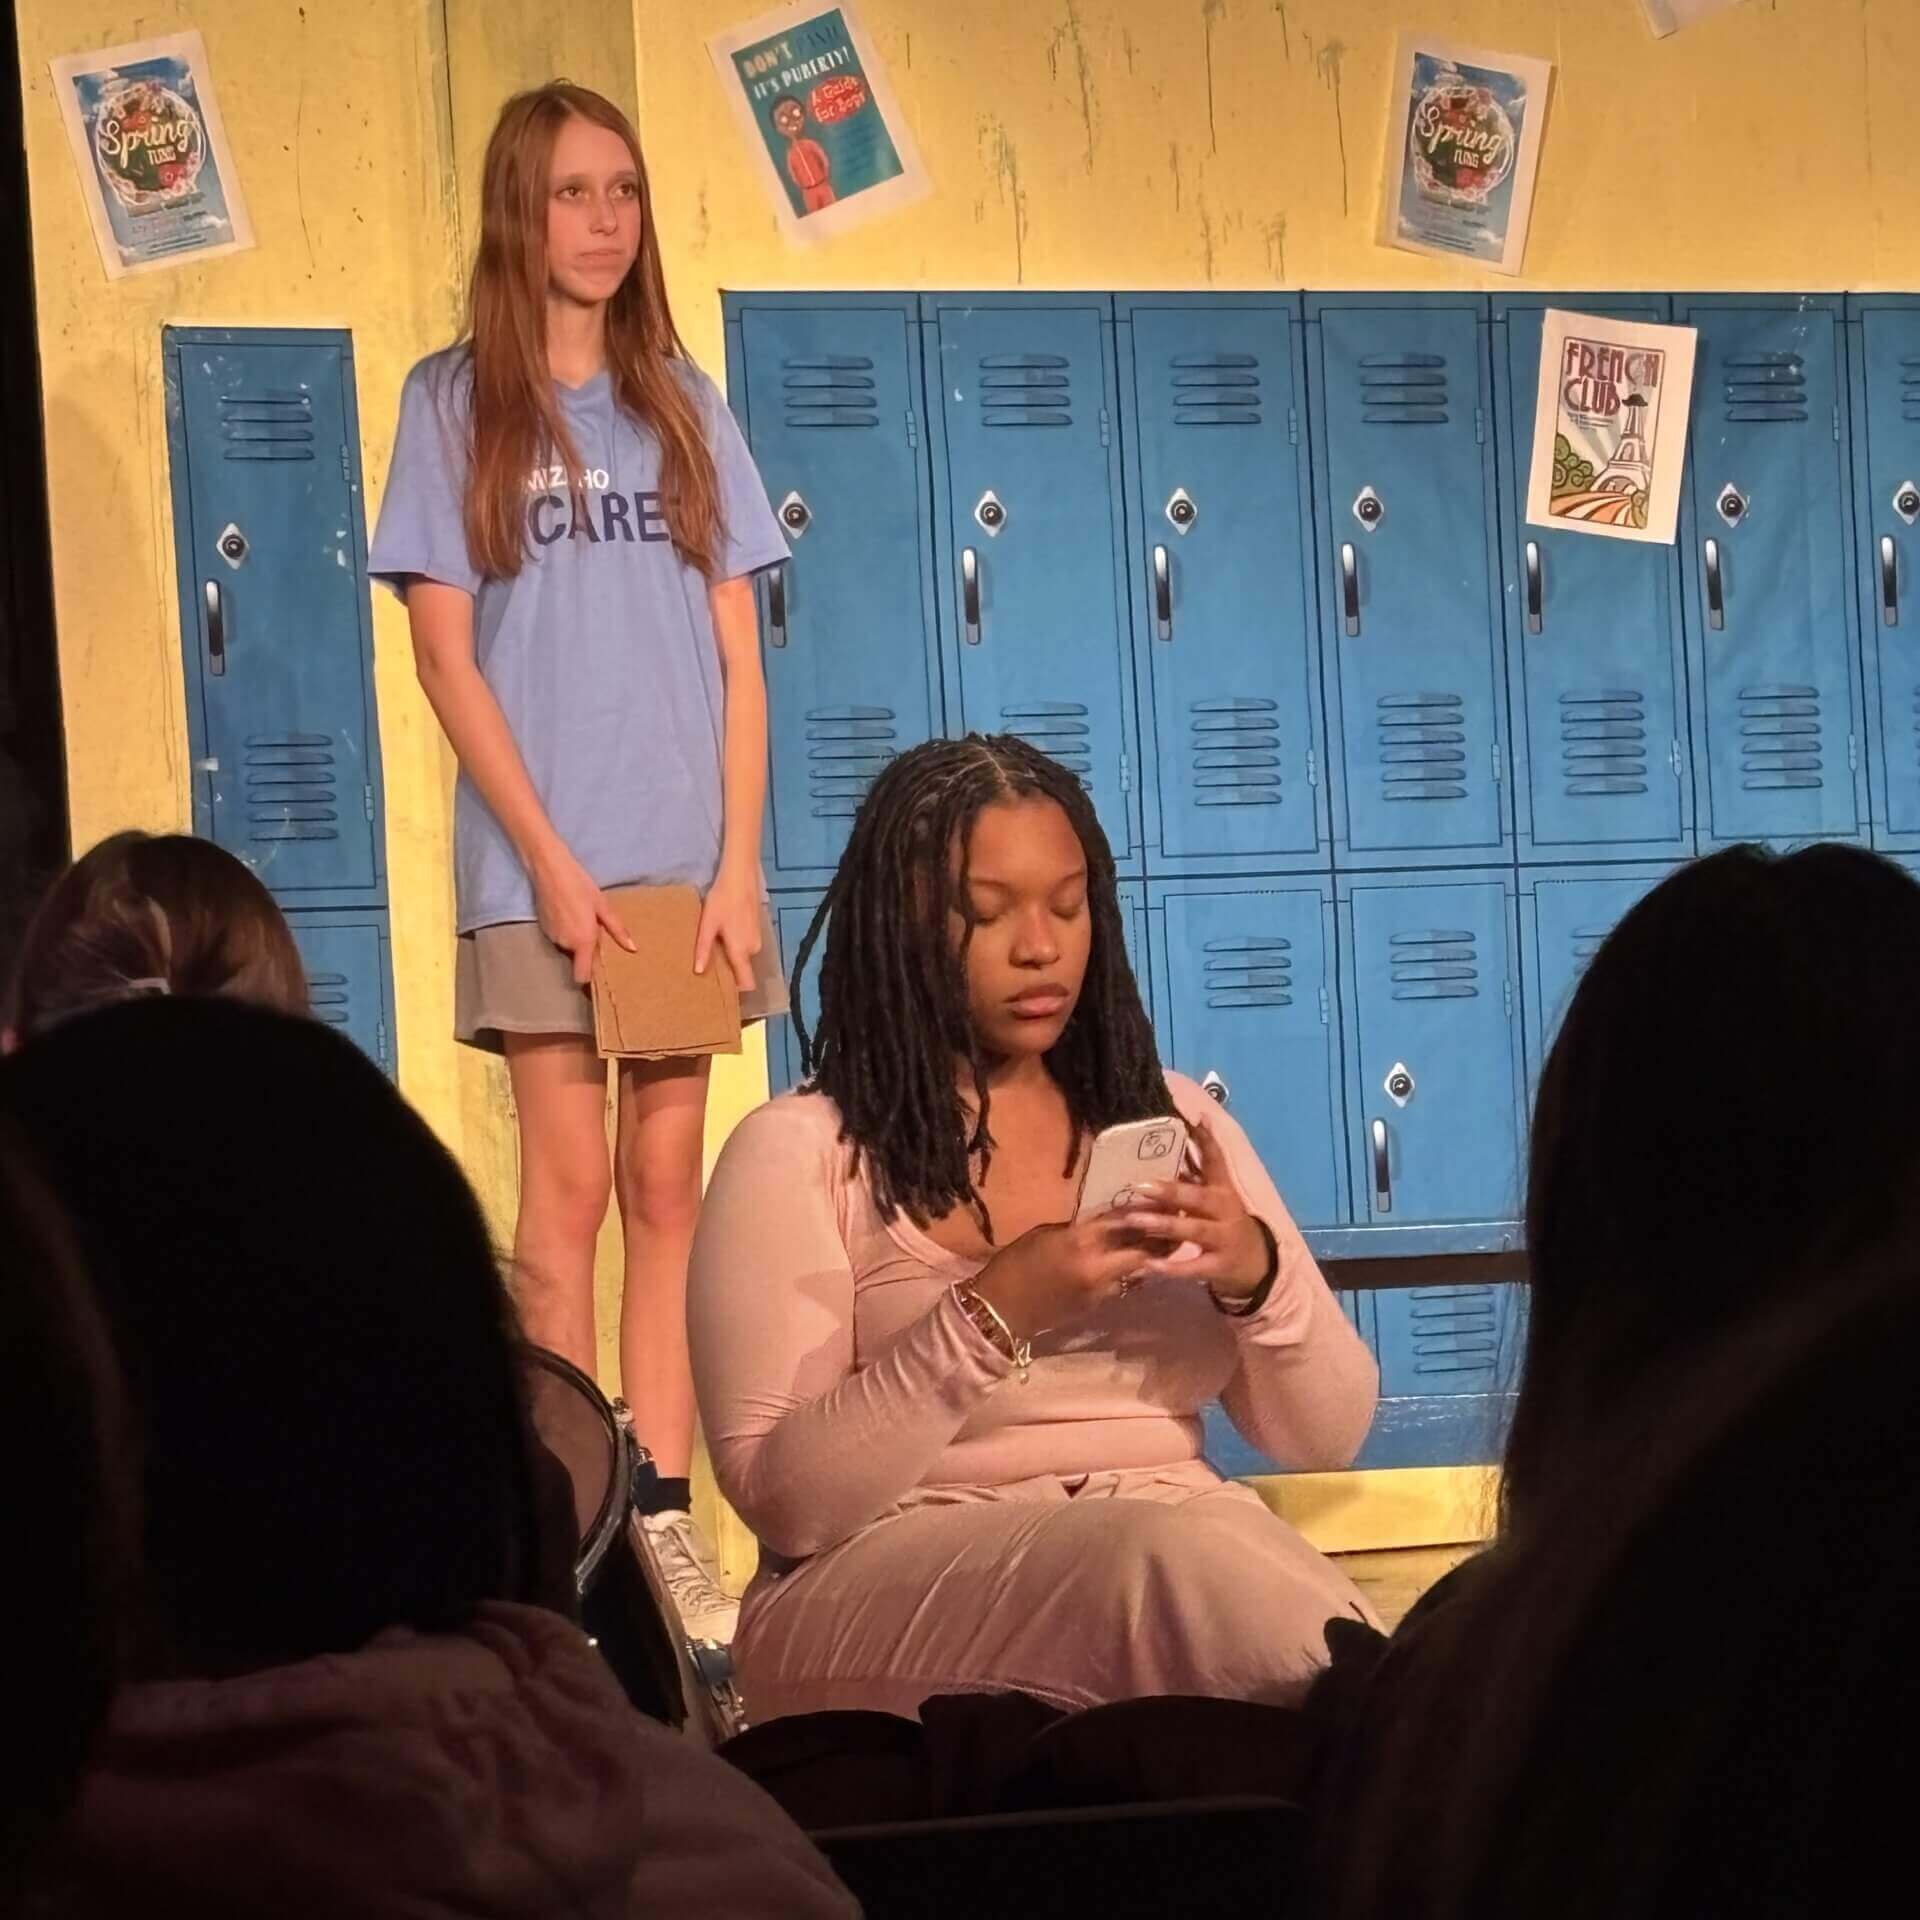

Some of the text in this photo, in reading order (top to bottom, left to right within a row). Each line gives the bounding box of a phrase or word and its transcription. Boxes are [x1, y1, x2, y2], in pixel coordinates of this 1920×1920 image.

[753, 76, 780, 100] IT'S
[102, 117, 196, 169] Spring
[1420, 105, 1502, 164] Spring
[1565, 341, 1660, 388] FRENCH
[1563, 376, 1622, 417] CLUB
[527, 465, 610, 490] MIZHO
